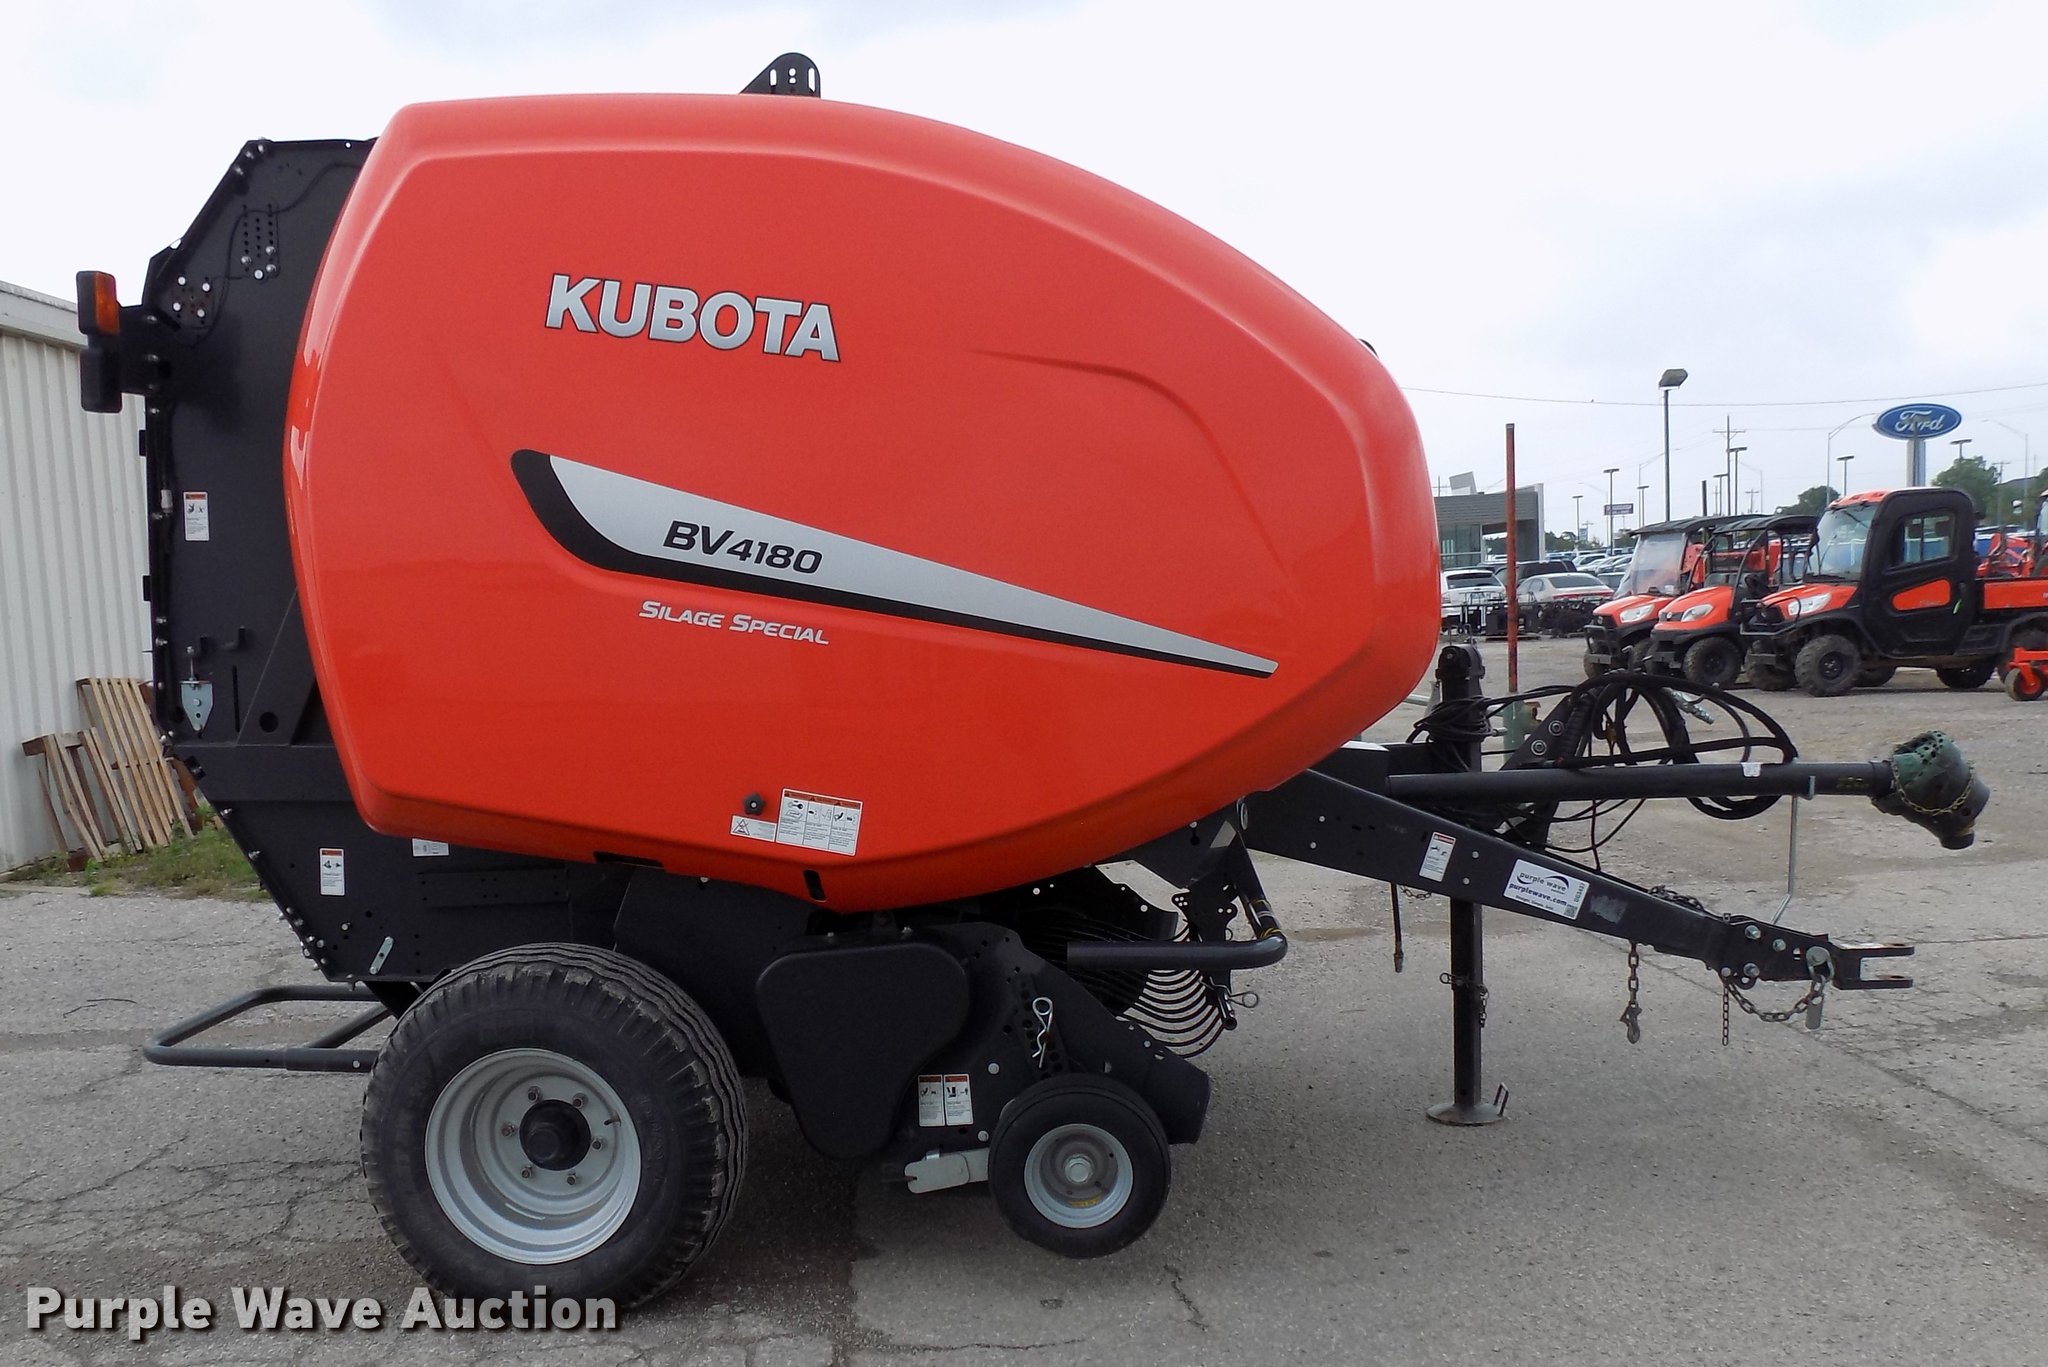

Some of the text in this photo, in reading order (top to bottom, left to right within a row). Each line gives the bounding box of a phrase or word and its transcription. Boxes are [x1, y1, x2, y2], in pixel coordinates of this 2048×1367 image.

[545, 273, 841, 362] KUBOTA
[1895, 409, 1946, 432] Ford
[662, 519, 823, 574] BV4180
[1519, 871, 1567, 891] purple wave
[1508, 882, 1567, 907] purplewave.com
